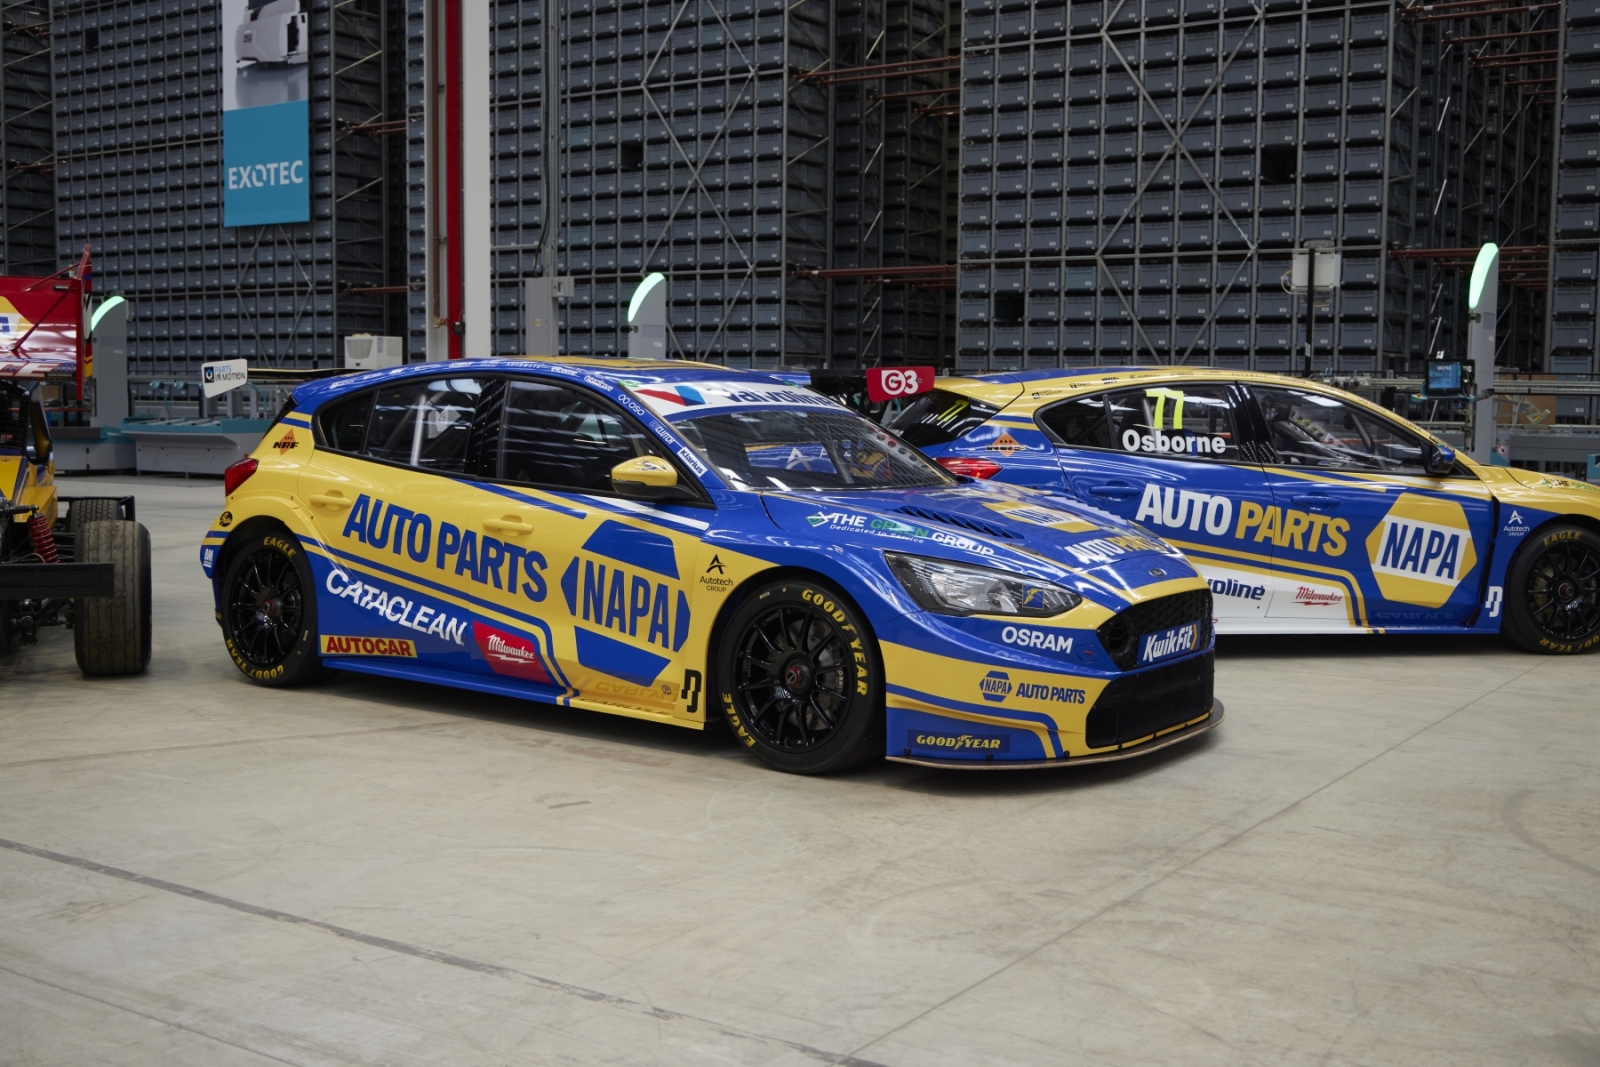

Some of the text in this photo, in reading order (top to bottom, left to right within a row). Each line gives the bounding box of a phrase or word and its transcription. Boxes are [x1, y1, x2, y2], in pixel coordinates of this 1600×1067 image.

[228, 160, 303, 190] EXOTEC
[215, 365, 231, 373] PARTS
[222, 372, 246, 381] MOTION
[881, 370, 918, 395] G3
[937, 400, 970, 422] 77
[1146, 390, 1184, 429] 77
[1122, 429, 1226, 453] Osborne
[680, 449, 705, 474] Klarius
[830, 524, 875, 535] Dedicated
[1135, 483, 1350, 557] AUTO PARTS
[1503, 525, 1529, 533] Autotech
[263, 536, 297, 558] EAGLE
[830, 513, 995, 556] THE GREEN GROUP
[1543, 530, 1582, 546] EAGLE
[342, 493, 548, 602] AUTO PARTS
[1380, 522, 1460, 580] NAPA
[700, 576, 733, 587] Autotech
[1295, 585, 1344, 603] Milwaukee
[326, 569, 467, 645] CATACLEAN
[582, 559, 669, 650] NAPA
[326, 637, 412, 656] AUTOCAR
[487, 633, 534, 660] Milwaukee
[1001, 626, 1073, 653] OSRAM
[983, 678, 1086, 704] NAPA AUTO PARTS
[722, 692, 756, 747] EAGLE
